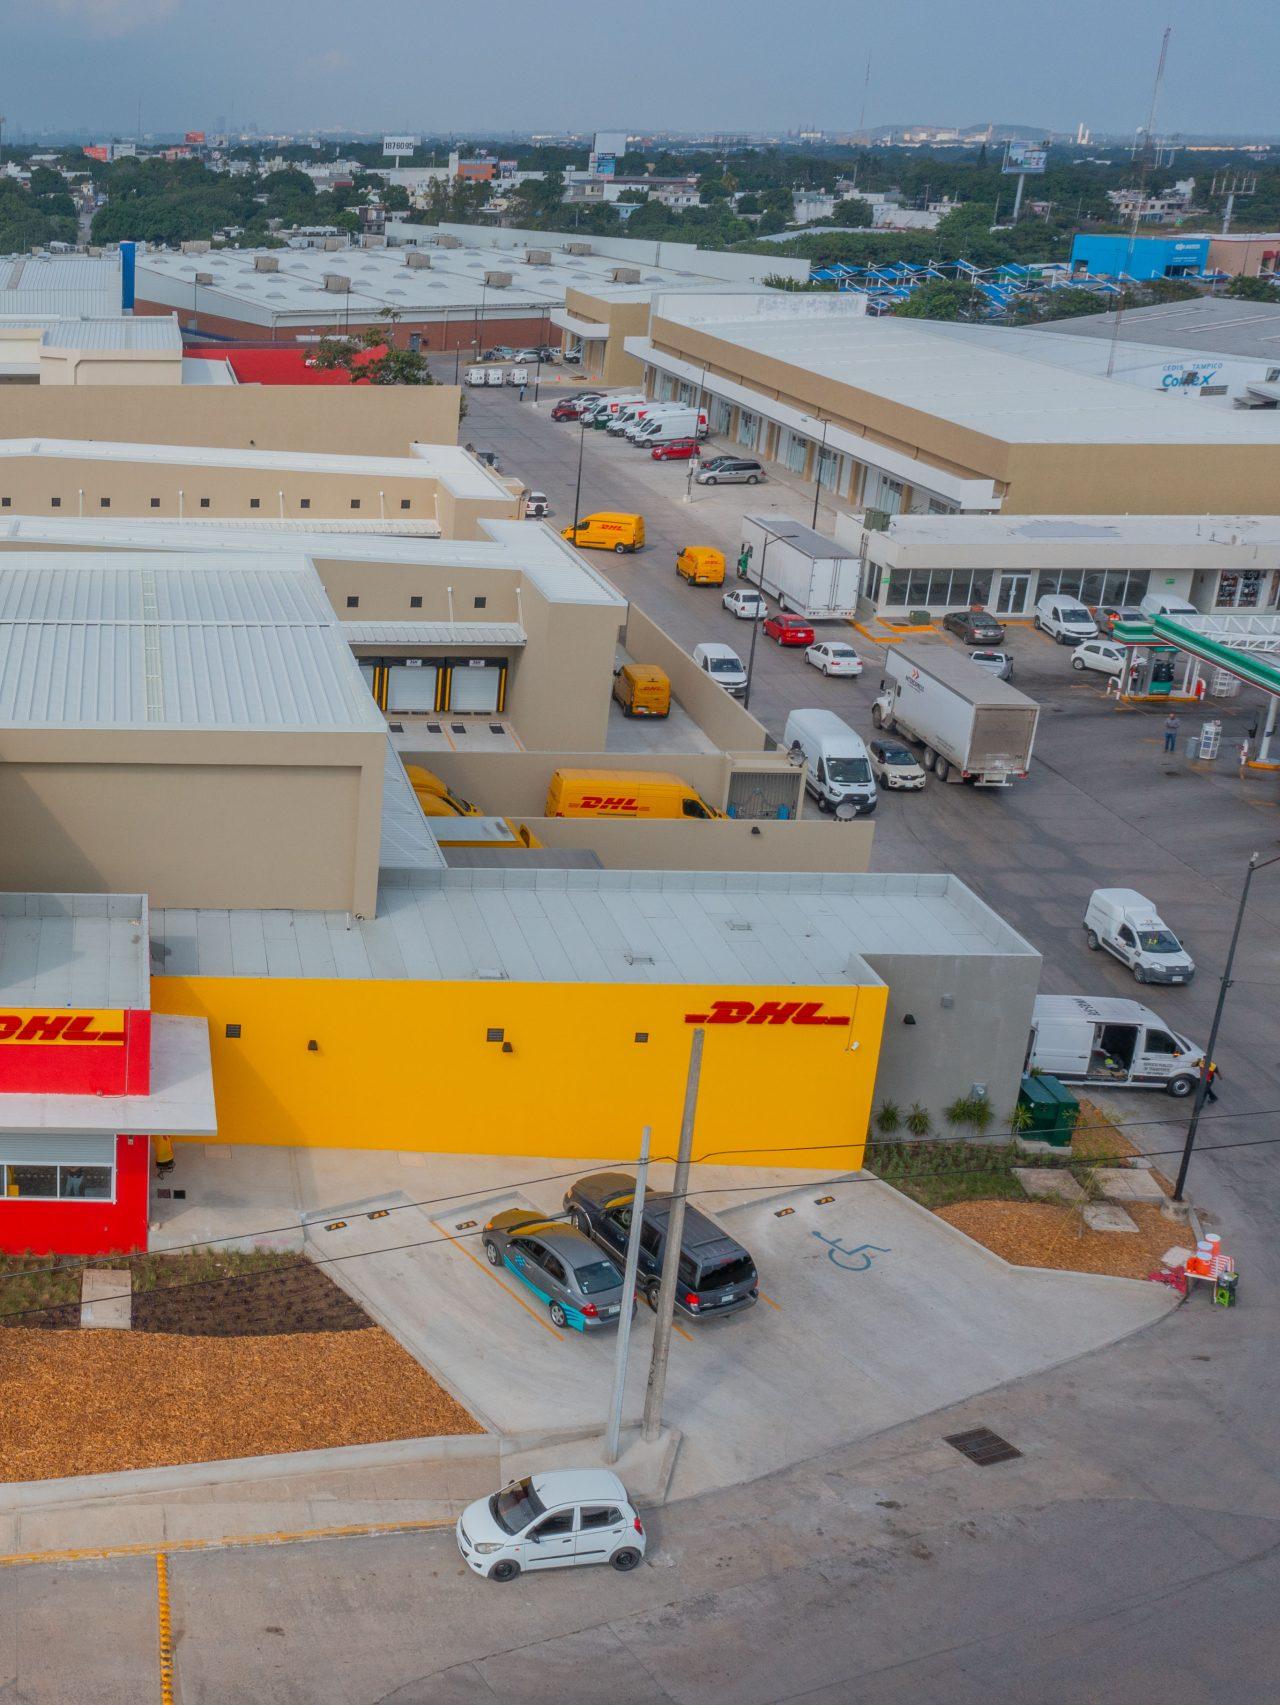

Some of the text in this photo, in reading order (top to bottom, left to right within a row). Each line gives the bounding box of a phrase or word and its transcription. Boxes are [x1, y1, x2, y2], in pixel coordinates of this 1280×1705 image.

[601, 523, 623, 531] DHL
[580, 796, 639, 811] DHL
[704, 1000, 830, 1025] DHL
